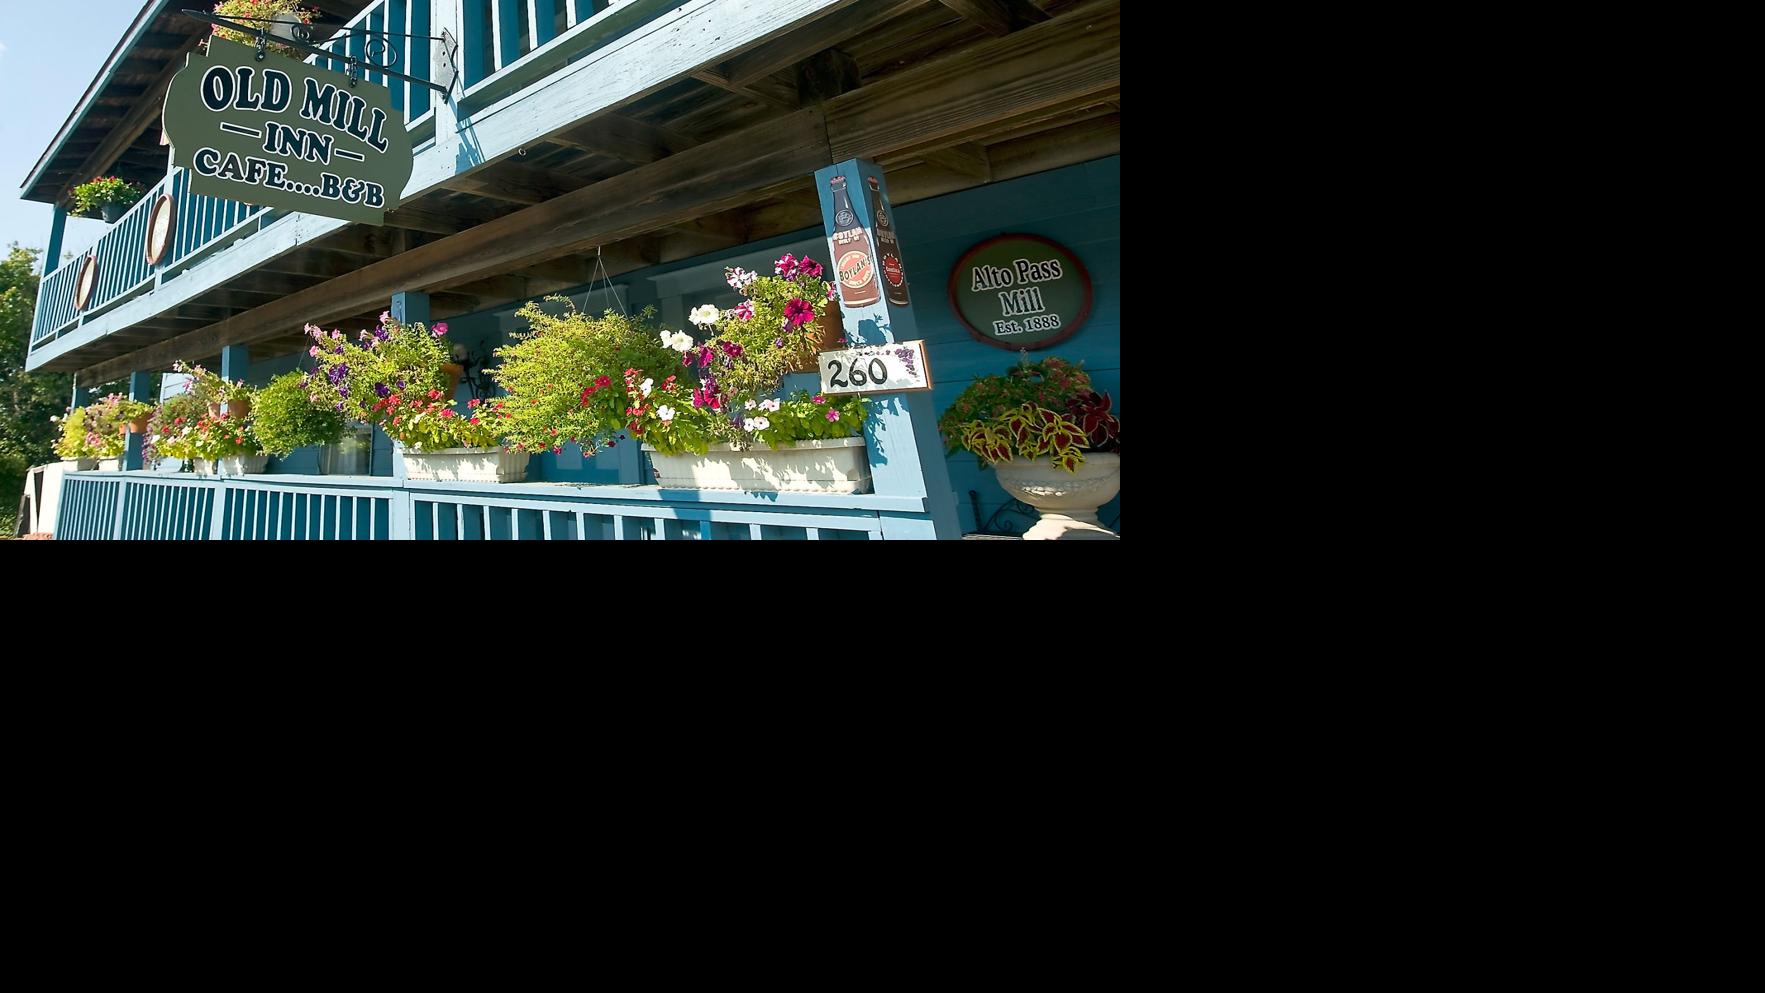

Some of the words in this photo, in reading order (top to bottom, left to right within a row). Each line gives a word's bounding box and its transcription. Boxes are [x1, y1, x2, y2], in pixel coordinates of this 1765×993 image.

[201, 65, 292, 112] OLD
[299, 77, 389, 153] MILL
[839, 255, 871, 282] BOYLAN'S
[971, 265, 1014, 291] Alto
[1013, 258, 1063, 284] Pass
[999, 287, 1045, 317] Mill
[993, 320, 1023, 335] Est.
[1024, 314, 1061, 332] 1888
[827, 356, 888, 388] 260
